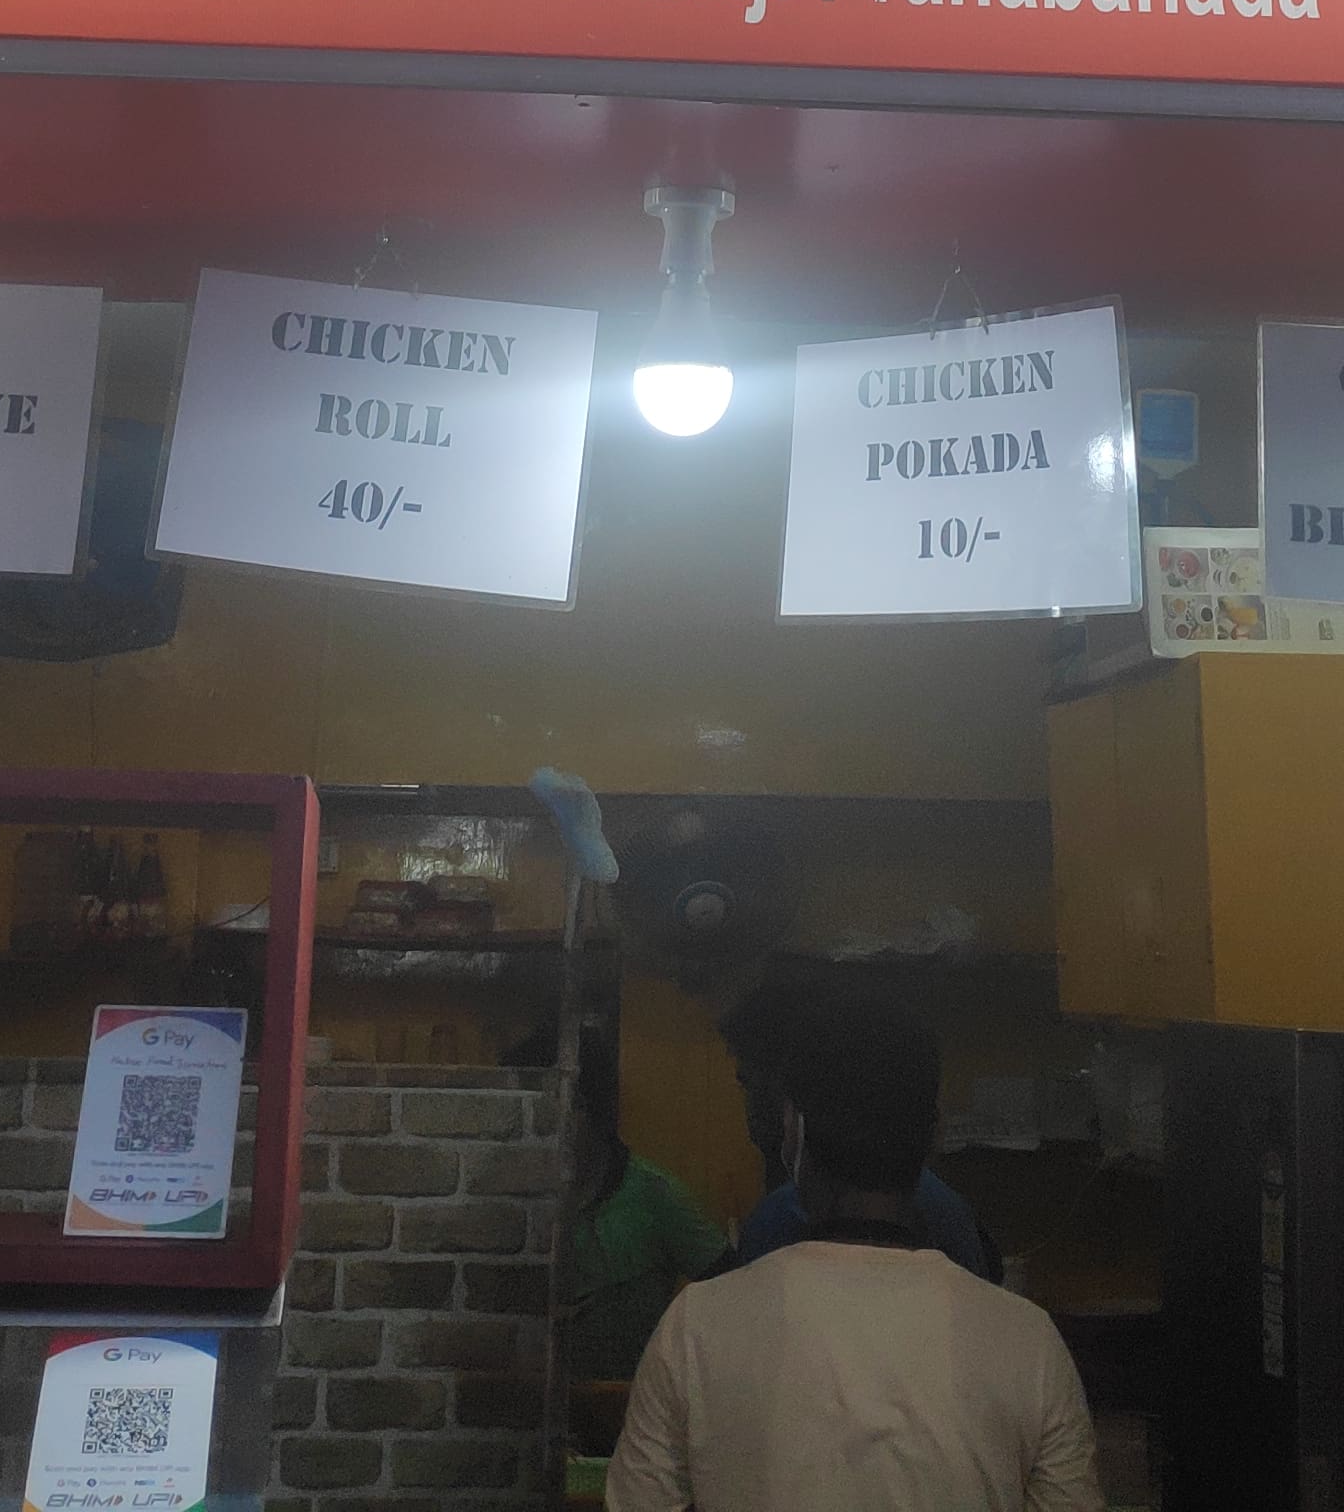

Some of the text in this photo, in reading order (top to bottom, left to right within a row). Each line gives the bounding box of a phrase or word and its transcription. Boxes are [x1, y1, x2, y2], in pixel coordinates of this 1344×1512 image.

[271, 311, 517, 376] CHICKEN
[857, 350, 1055, 409] CHICKEN
[314, 392, 452, 448] ROLL
[865, 429, 1051, 481] POKADA
[318, 479, 423, 531] 40/-
[917, 516, 1001, 563] 10/-
[164, 1029, 196, 1049] Pay
[102, 1347, 163, 1365] G Pay
[46, 1492, 115, 1508] BHIM
